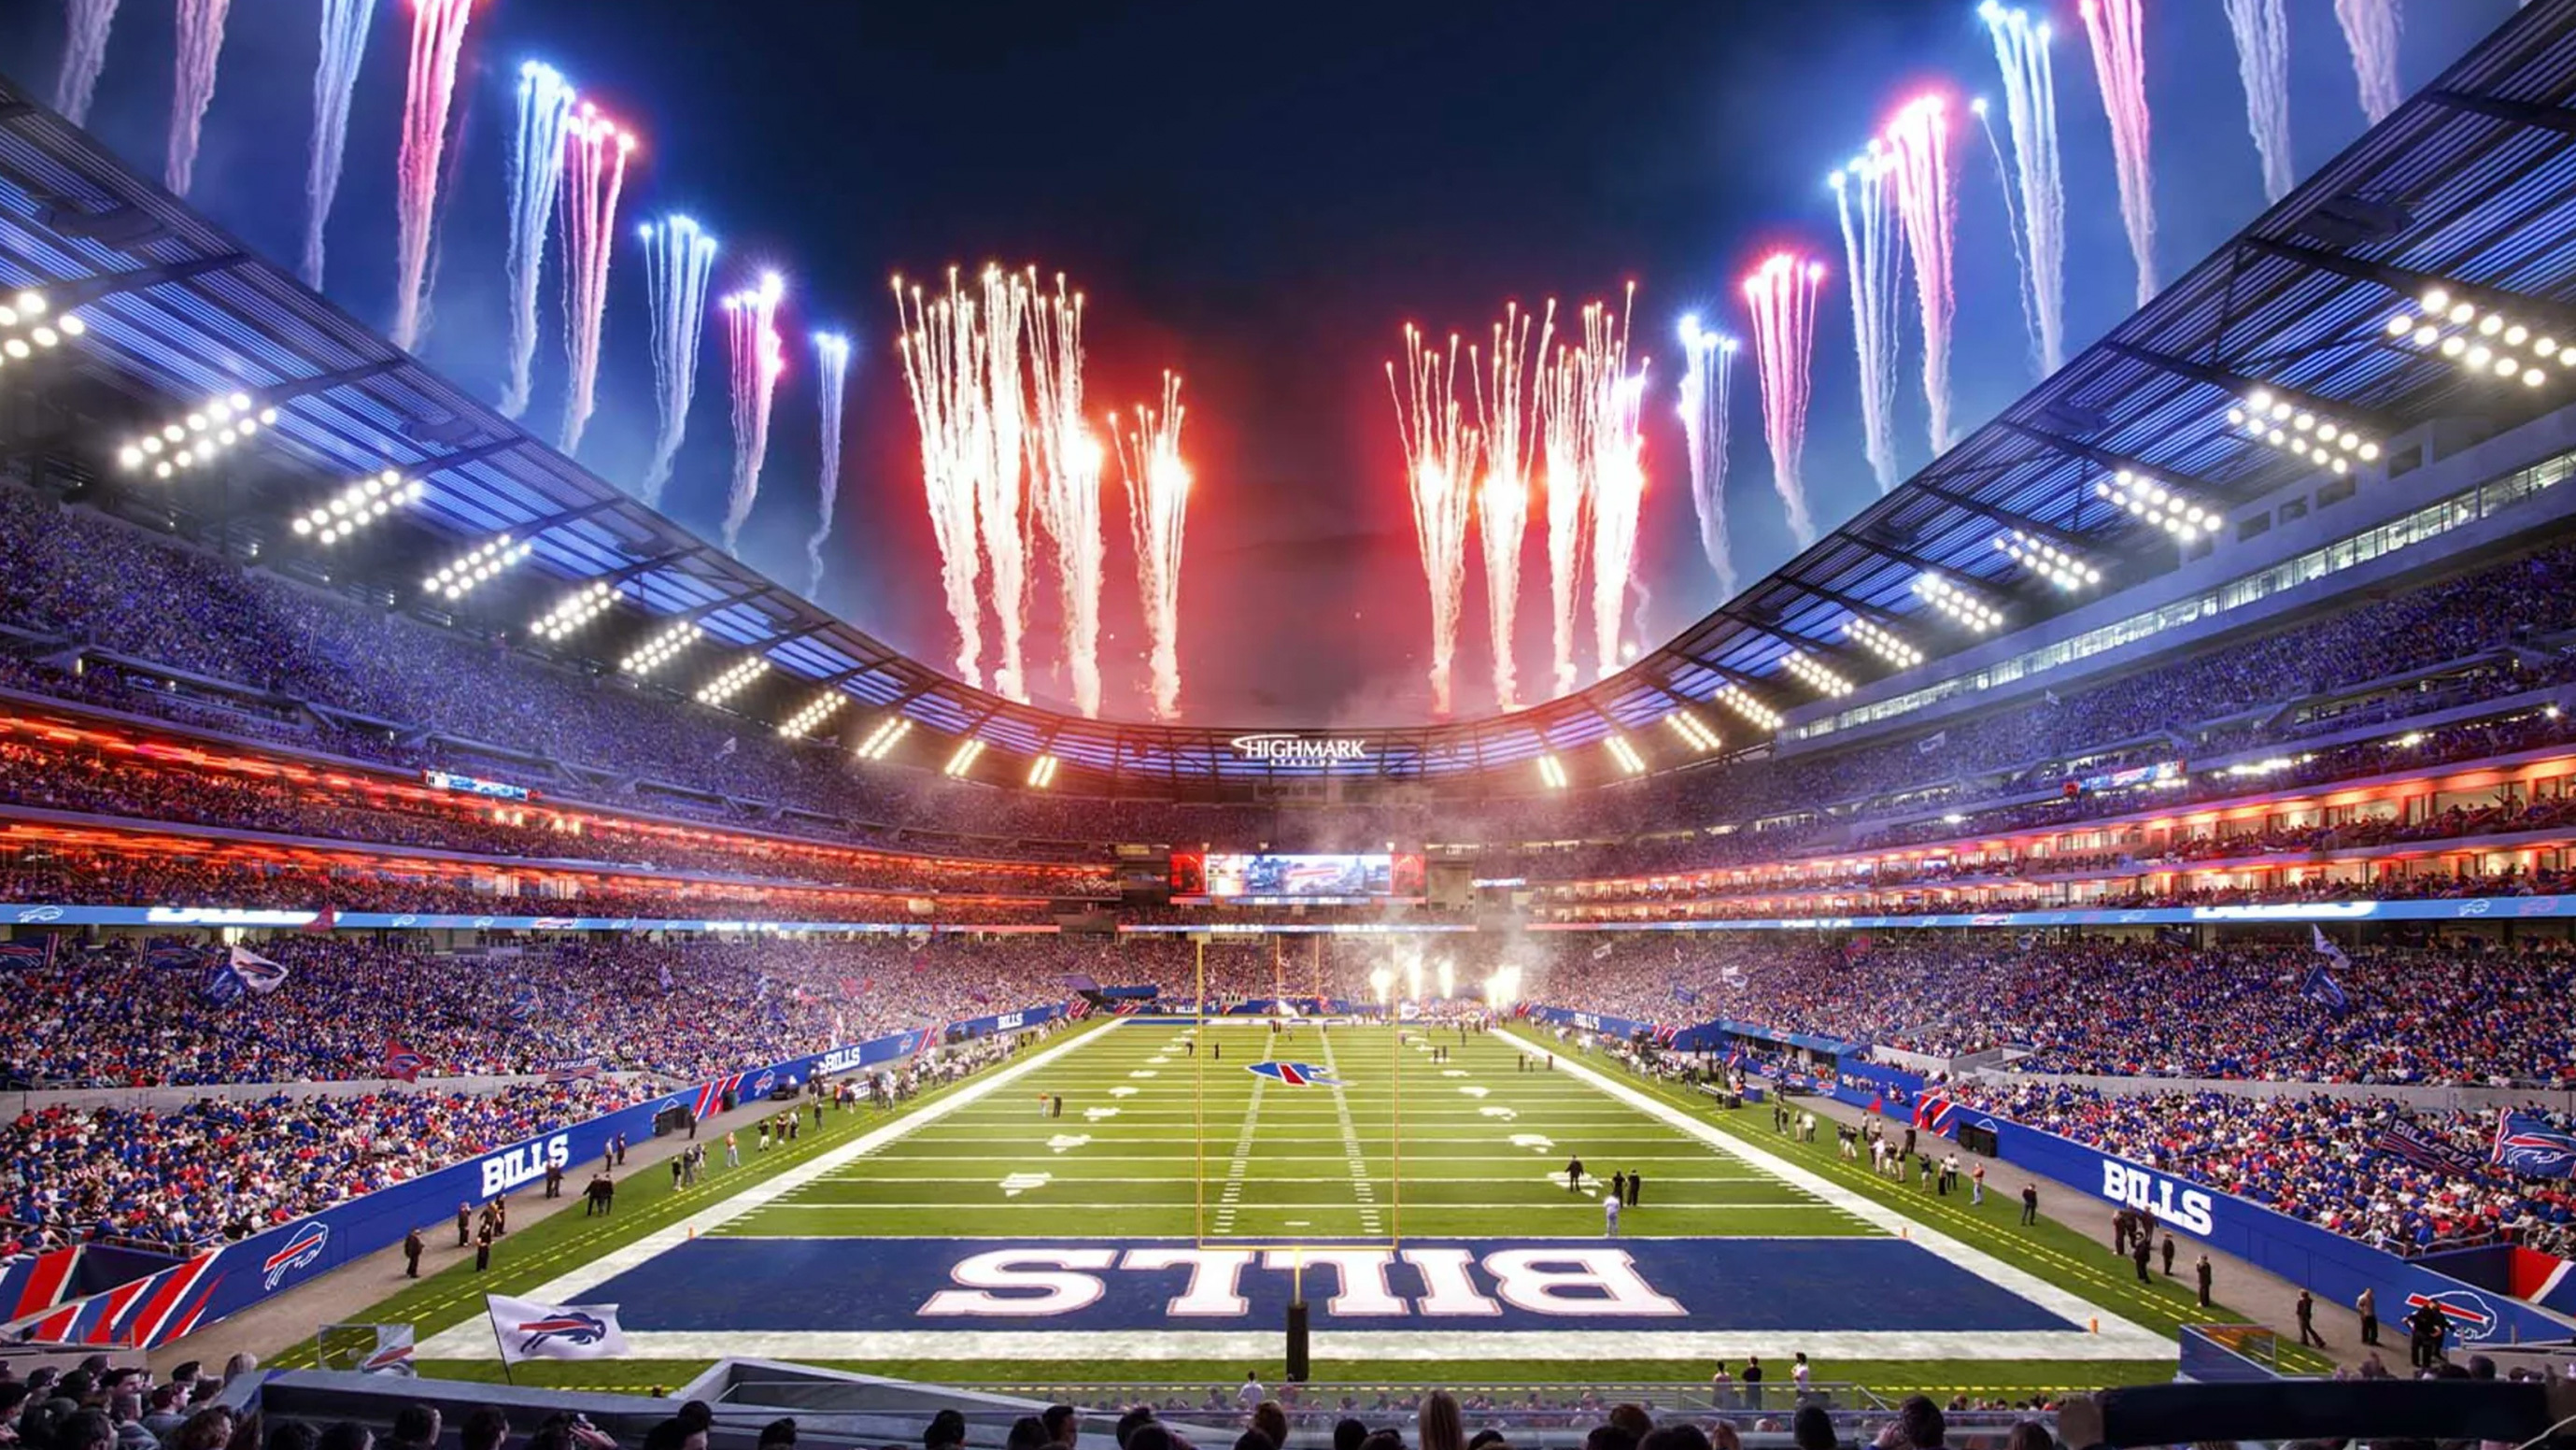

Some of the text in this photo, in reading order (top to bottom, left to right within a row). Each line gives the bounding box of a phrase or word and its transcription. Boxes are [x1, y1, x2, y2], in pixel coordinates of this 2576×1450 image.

[1246, 739, 1366, 758] HIGHMARK
[998, 1013, 1024, 1030] BILLS
[1575, 1013, 1600, 1030] BILLS
[825, 1046, 860, 1073] BILLS
[482, 1133, 569, 1198] BILLS
[2102, 1159, 2213, 1236] BILLS
[915, 1248, 1690, 1316] BILLS
